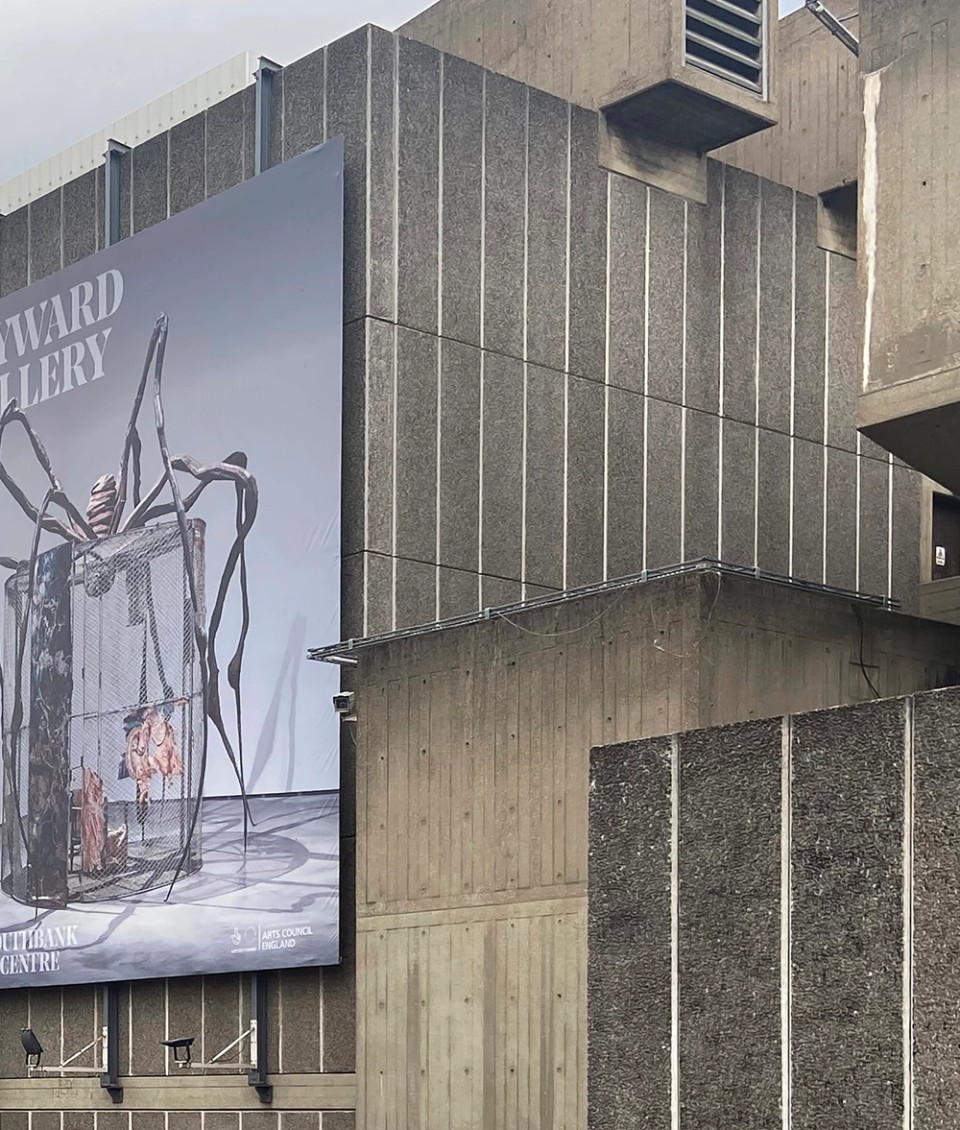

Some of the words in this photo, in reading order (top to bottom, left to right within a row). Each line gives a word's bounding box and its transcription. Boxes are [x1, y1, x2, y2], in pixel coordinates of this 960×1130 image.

[262, 930, 280, 940] ARTS
[281, 926, 313, 938] COUNCIL
[261, 939, 296, 950] ENGLAND
[0, 951, 60, 975] CENTRE
